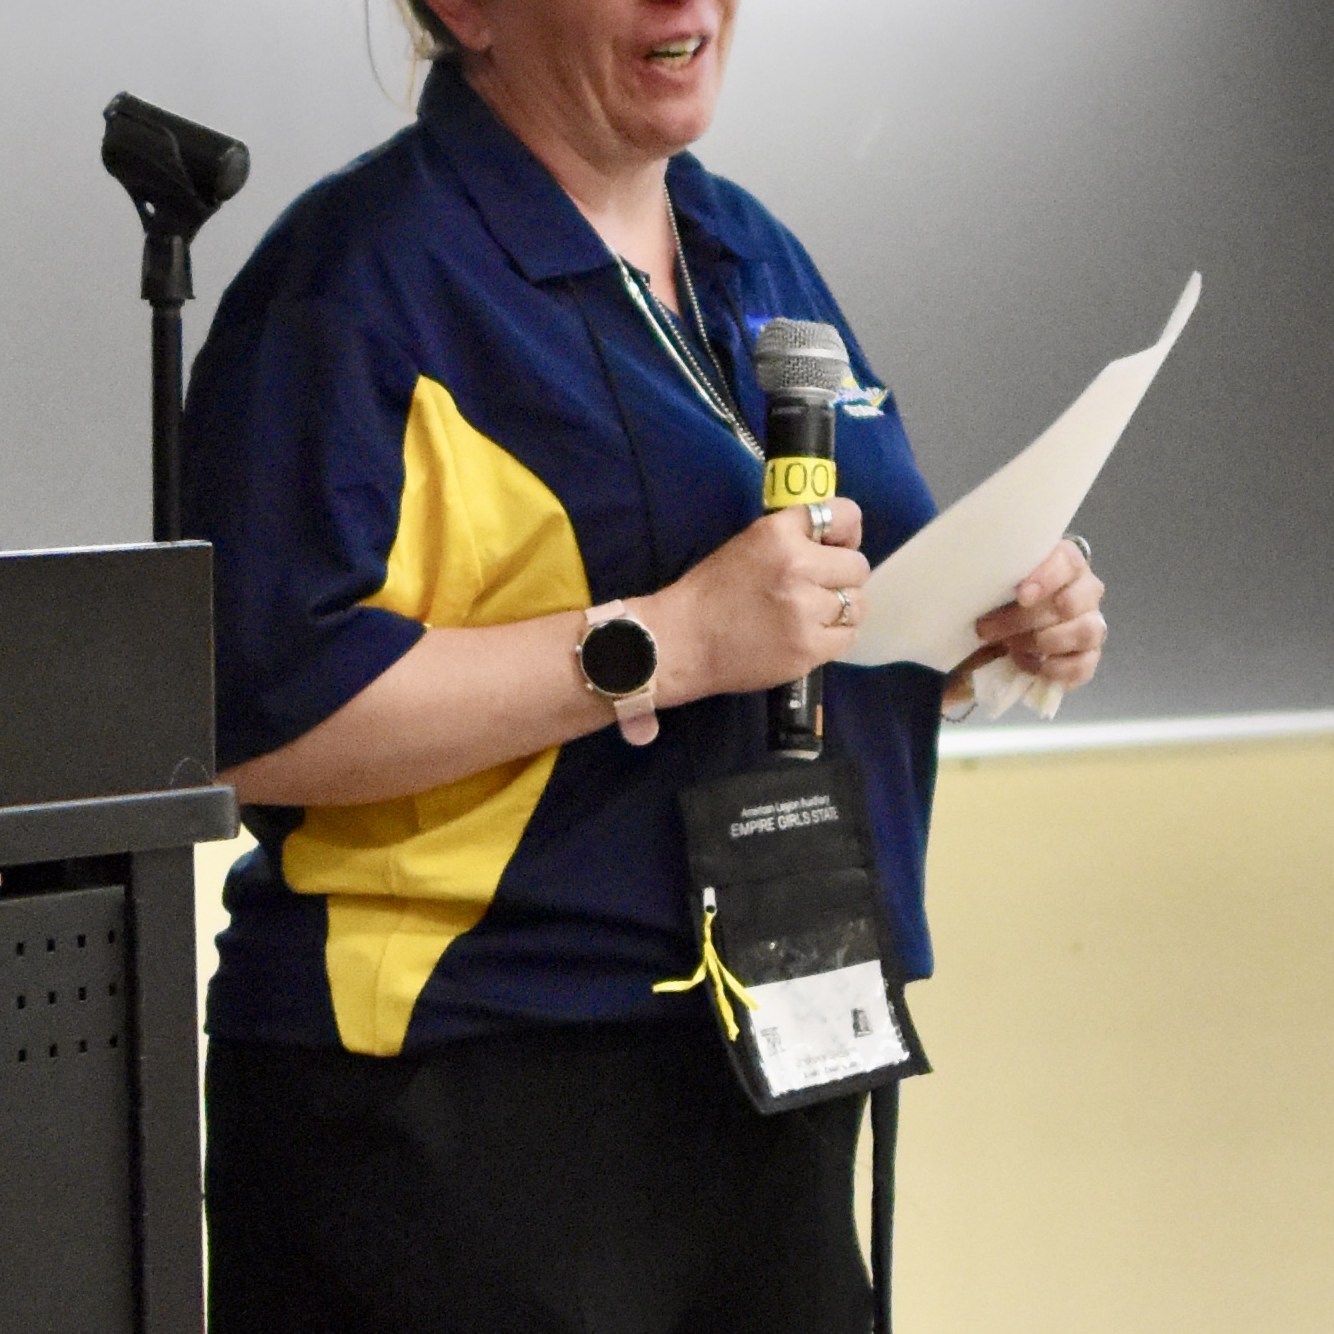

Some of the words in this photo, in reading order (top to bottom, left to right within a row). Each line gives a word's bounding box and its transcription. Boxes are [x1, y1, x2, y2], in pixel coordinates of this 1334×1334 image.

[730, 816, 776, 838] EMPIRE
[777, 811, 812, 830] GIRLS
[811, 806, 839, 824] STATE
